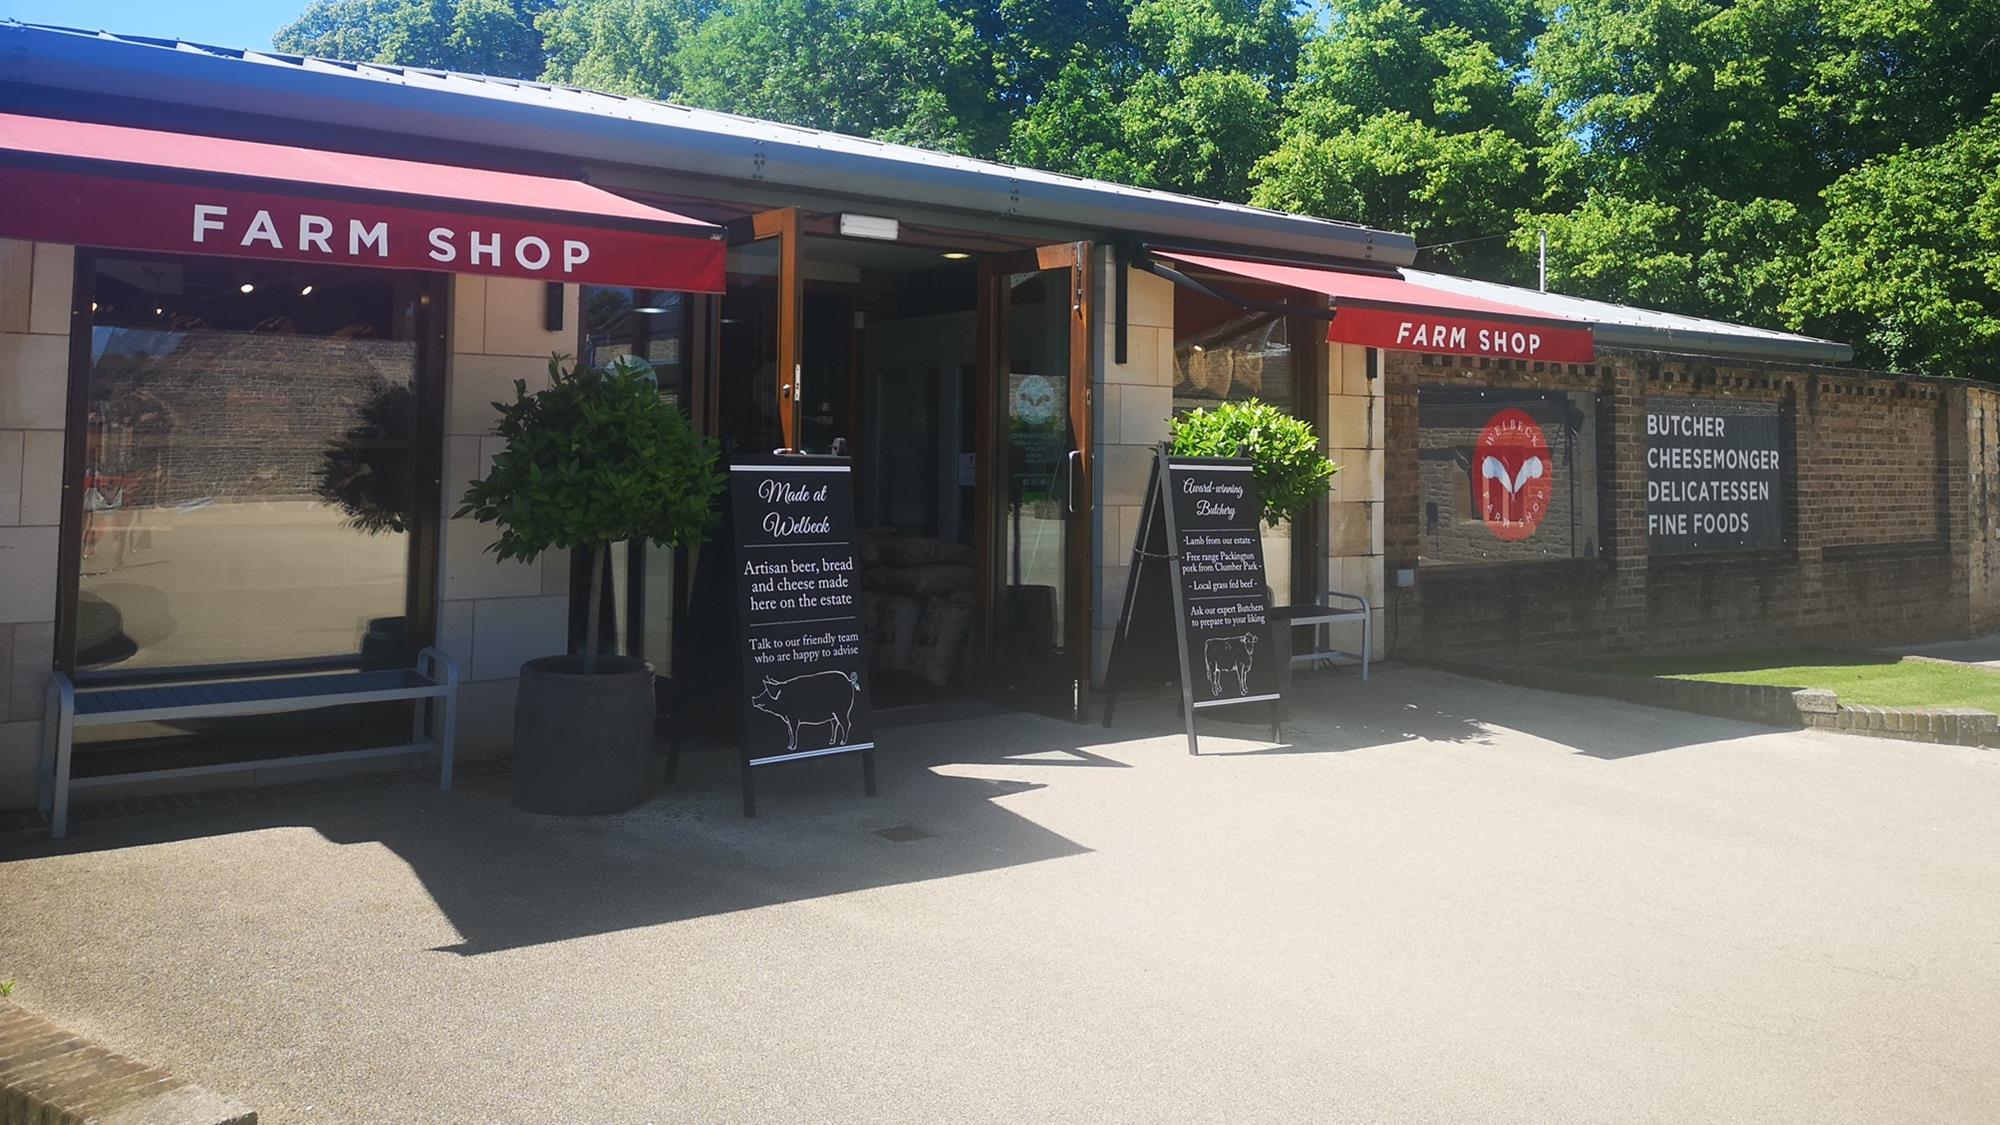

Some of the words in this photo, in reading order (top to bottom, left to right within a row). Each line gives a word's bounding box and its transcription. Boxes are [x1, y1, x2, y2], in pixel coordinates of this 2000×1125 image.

[192, 204, 389, 257] FARM
[427, 227, 591, 273] SHOP
[1396, 322, 1466, 349] FARM
[1479, 329, 1542, 355] SHOP
[1486, 419, 1540, 448] WELBECK
[1647, 414, 1725, 437] BUTCHER
[1647, 447, 1780, 470] CHEESEMONGER
[758, 478, 810, 504] Made
[812, 484, 828, 502] at
[1183, 477, 1244, 499] Award-winning
[1648, 480, 1769, 503] DELICATESSEN
[1196, 499, 1236, 521] Butchery
[1482, 490, 1510, 528] FARM
[1518, 490, 1543, 528] SHOP
[762, 511, 831, 538] Welbeck
[1648, 515, 1687, 536] FINE
[1693, 512, 1749, 535] FOODS
[1205, 536, 1221, 545] from
[1222, 537, 1233, 545] our
[1233, 537, 1251, 545] estate
[743, 560, 789, 576] Artisan
[790, 559, 820, 575] beer,
[821, 556, 854, 572] bread
[1186, 551, 1201, 562] Free
[1201, 553, 1219, 564] range
[1220, 550, 1255, 563] Packington
[1182, 563, 1198, 576] pork
[1198, 562, 1214, 572] from
[1214, 562, 1243, 572] Clumber
[1242, 561, 1258, 571] Park
[751, 577, 775, 593] and
[776, 576, 815, 592] cheese
[818, 573, 849, 590] made
[1193, 580, 1212, 591] Local
[1212, 582, 1229, 593] grass
[1228, 579, 1240, 589] fed
[1239, 578, 1254, 589] beef
[750, 596, 778, 611] here
[779, 598, 796, 609] on
[798, 593, 818, 608] the
[819, 594, 853, 607] estate
[1190, 605, 1204, 616] Ask
[1204, 607, 1216, 615] our
[1216, 605, 1237, 617] expert
[1236, 602, 1264, 613] Butchers
[1191, 619, 1199, 627] to
[1200, 618, 1224, 630] prepare
[1224, 616, 1232, 625] to
[1232, 616, 1247, 628] your
[1246, 613, 1266, 625] liking
[748, 638, 772, 651] Talk
[773, 639, 784, 649] to
[784, 638, 801, 648] our
[802, 632, 837, 647] friendly
[837, 633, 859, 643] team
[754, 651, 775, 664] who
[776, 652, 791, 662] are
[792, 649, 820, 663] happy
[821, 648, 832, 658] to
[832, 644, 859, 657] advise
